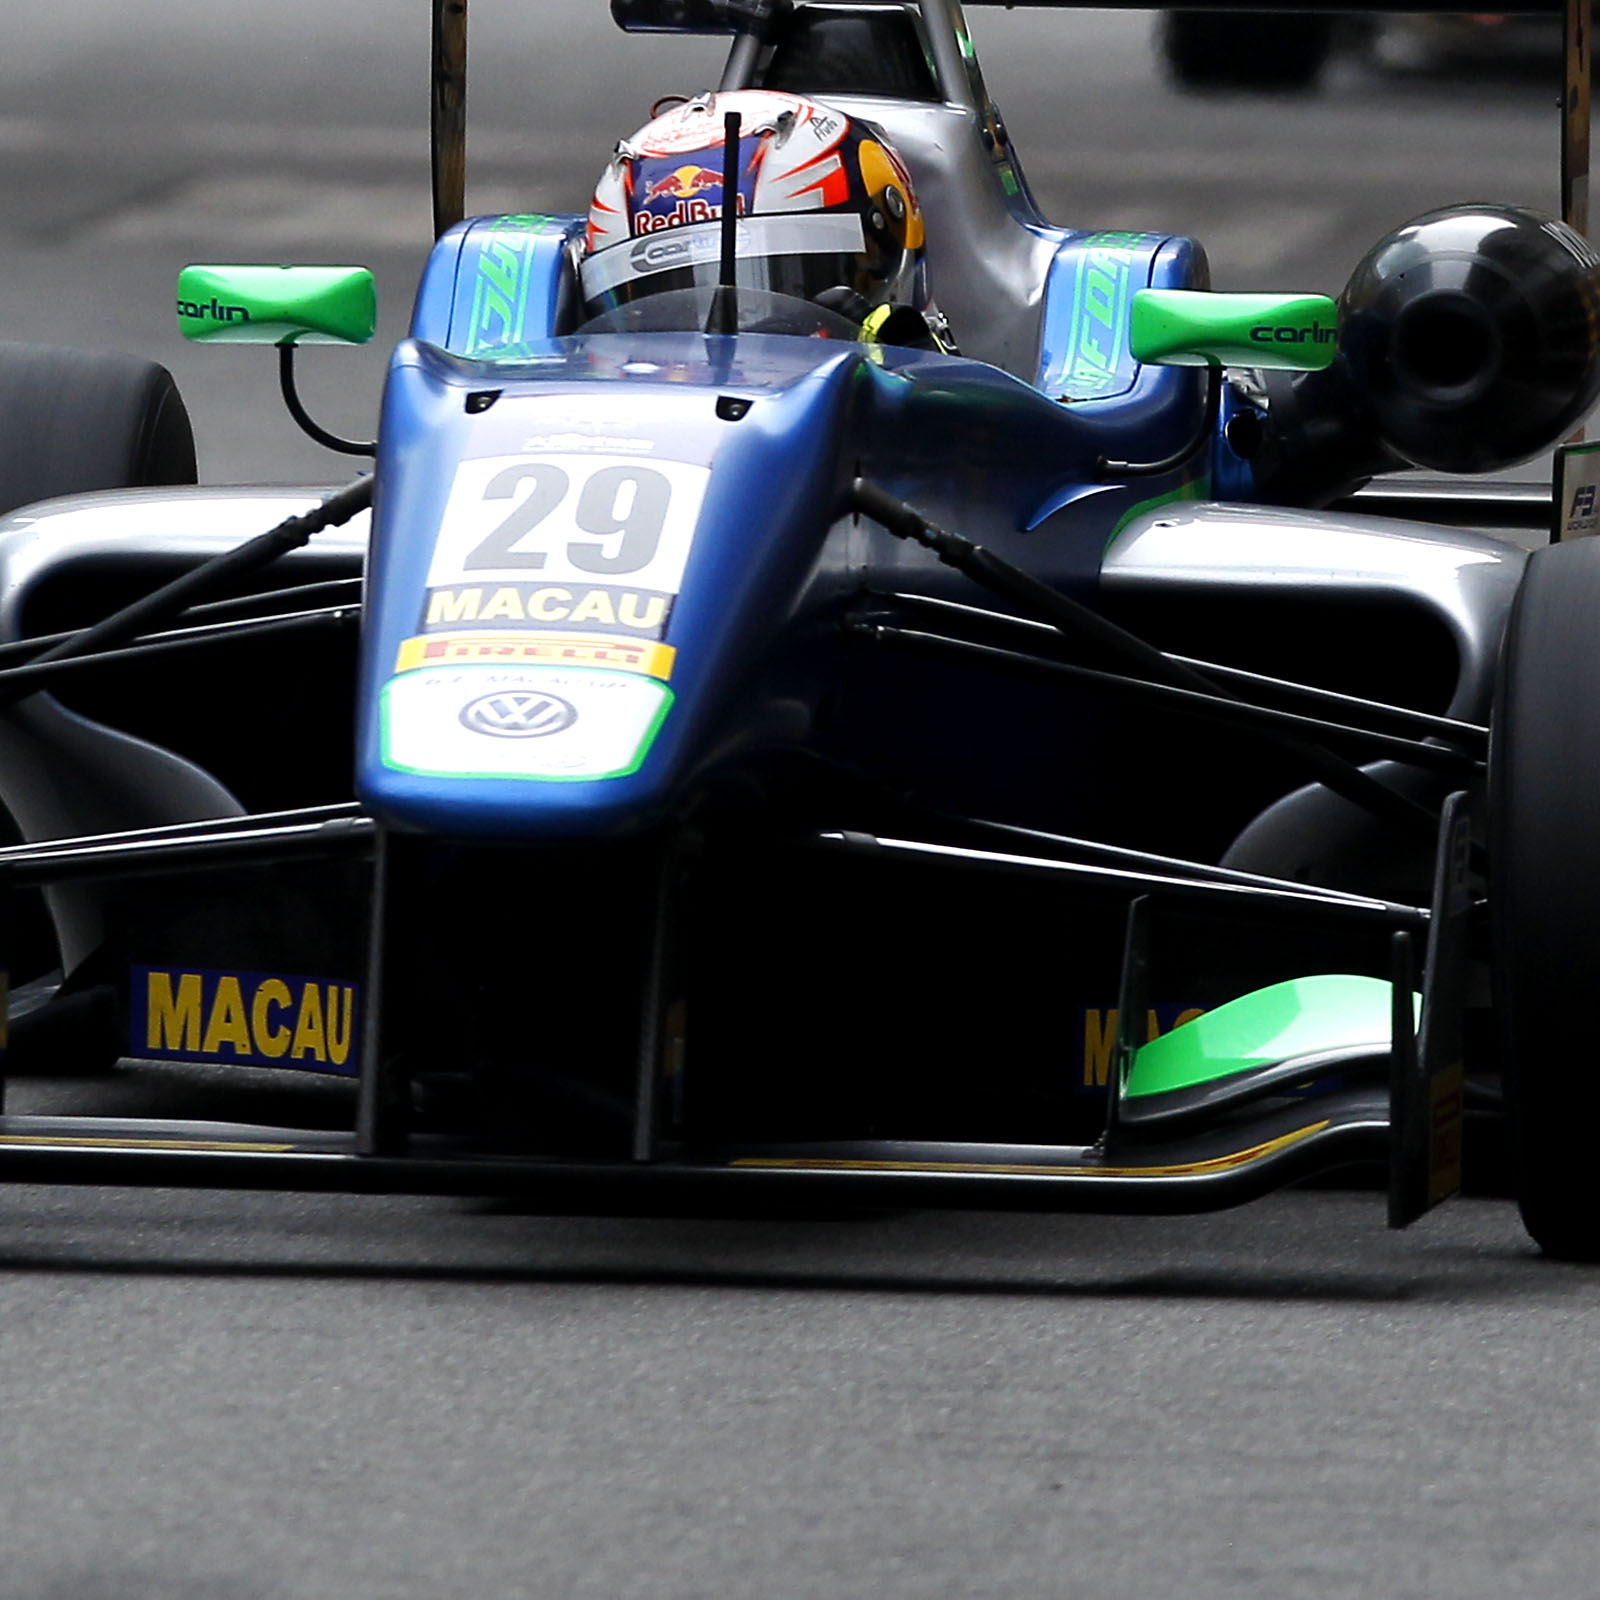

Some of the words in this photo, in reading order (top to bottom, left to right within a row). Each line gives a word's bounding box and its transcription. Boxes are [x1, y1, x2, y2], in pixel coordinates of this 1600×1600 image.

[634, 201, 686, 236] Red
[688, 194, 746, 222] Bl
[177, 298, 249, 321] carlin
[1250, 322, 1338, 343] carlin
[462, 462, 673, 576] 29
[426, 586, 667, 629] MACAU
[423, 637, 646, 664] PIRELLI
[147, 970, 354, 1066] MACAU
